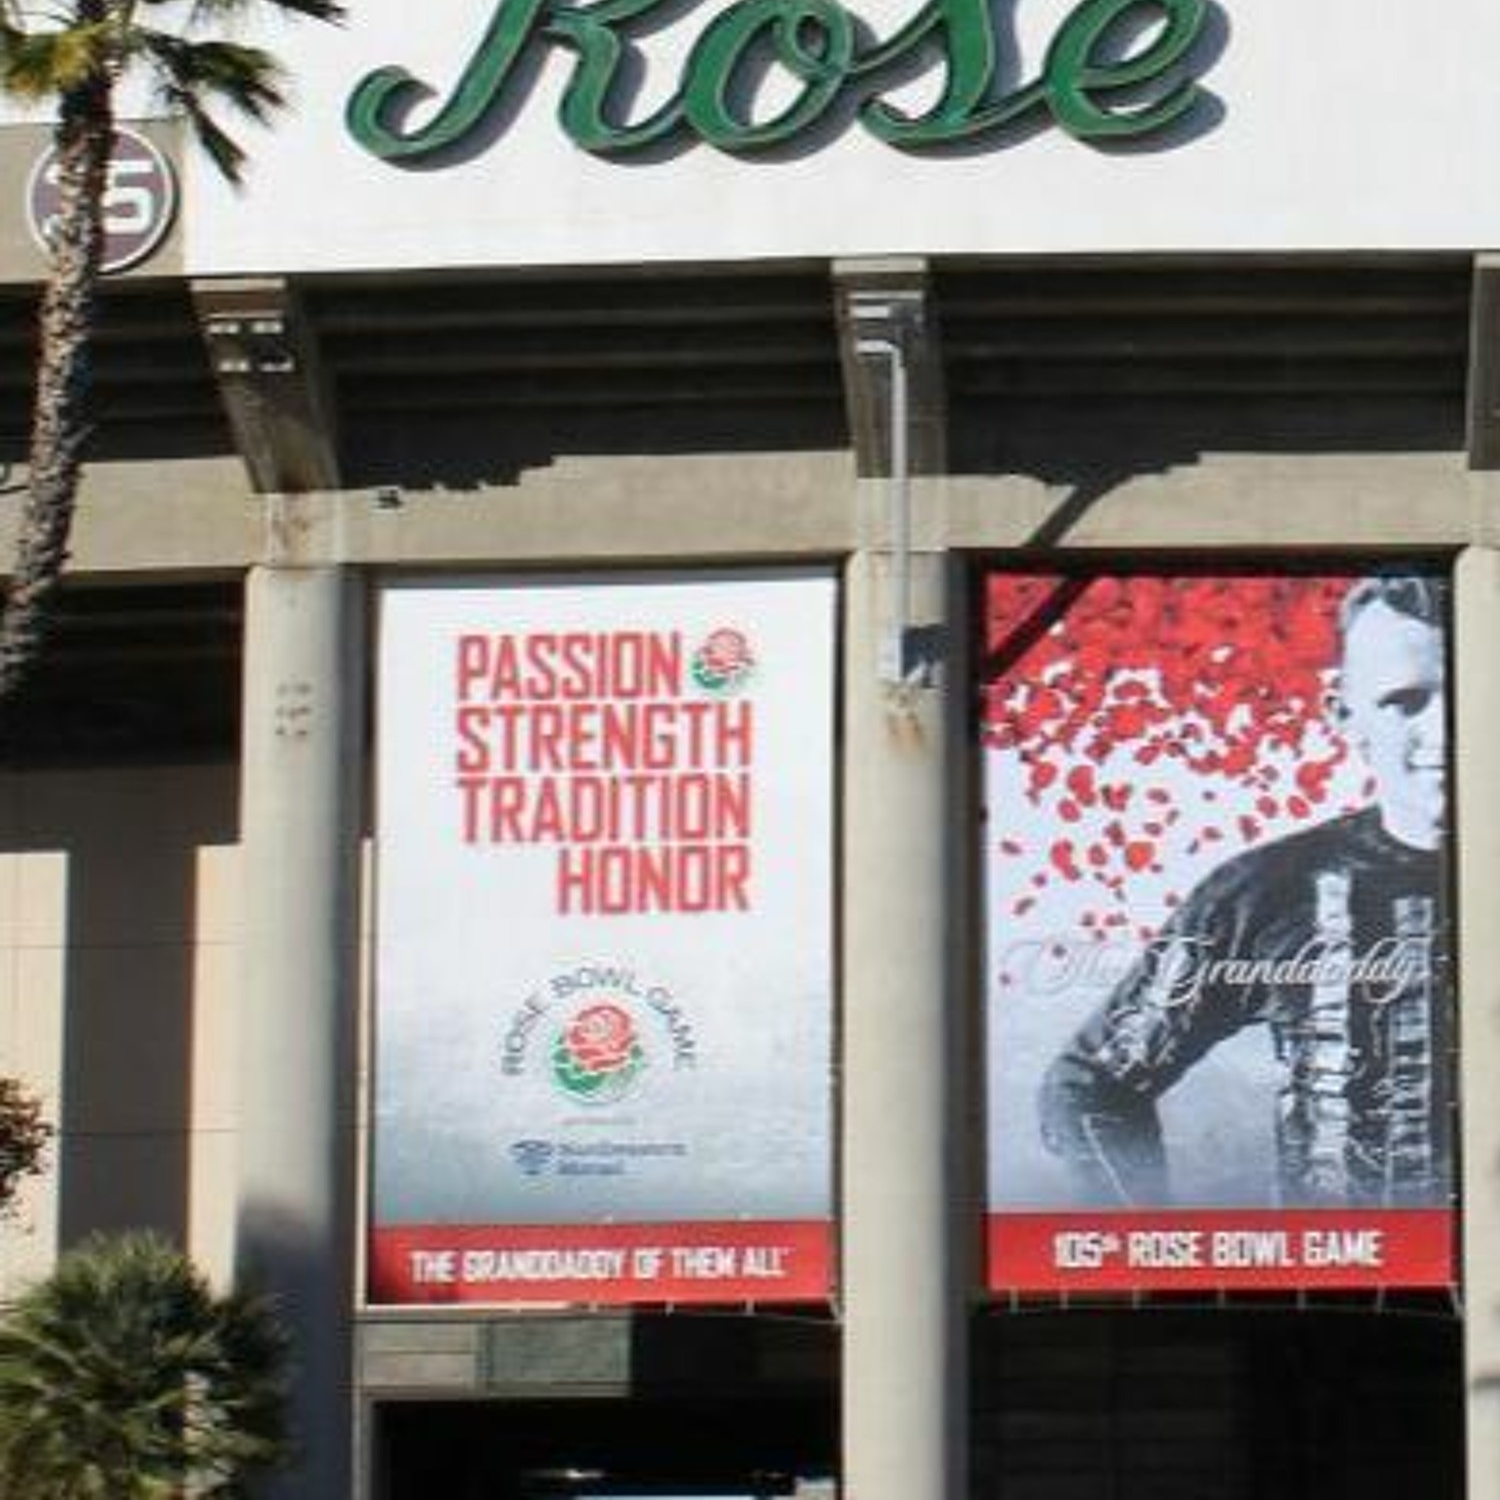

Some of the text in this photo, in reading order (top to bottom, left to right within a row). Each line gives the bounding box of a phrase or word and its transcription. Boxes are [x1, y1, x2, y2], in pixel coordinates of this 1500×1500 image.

[457, 631, 681, 700] PASSION
[456, 701, 751, 773] STRENGTH
[457, 773, 750, 843] TRADITION
[558, 845, 750, 915] HONOR
[501, 967, 697, 1076] ROSE BOWL GAME
[410, 1247, 788, 1284] THE GRANDDADDY OF THEM ALL
[1127, 1230, 1204, 1268] ROSE
[1212, 1230, 1295, 1268] BOWL
[1303, 1230, 1384, 1267] GAME
